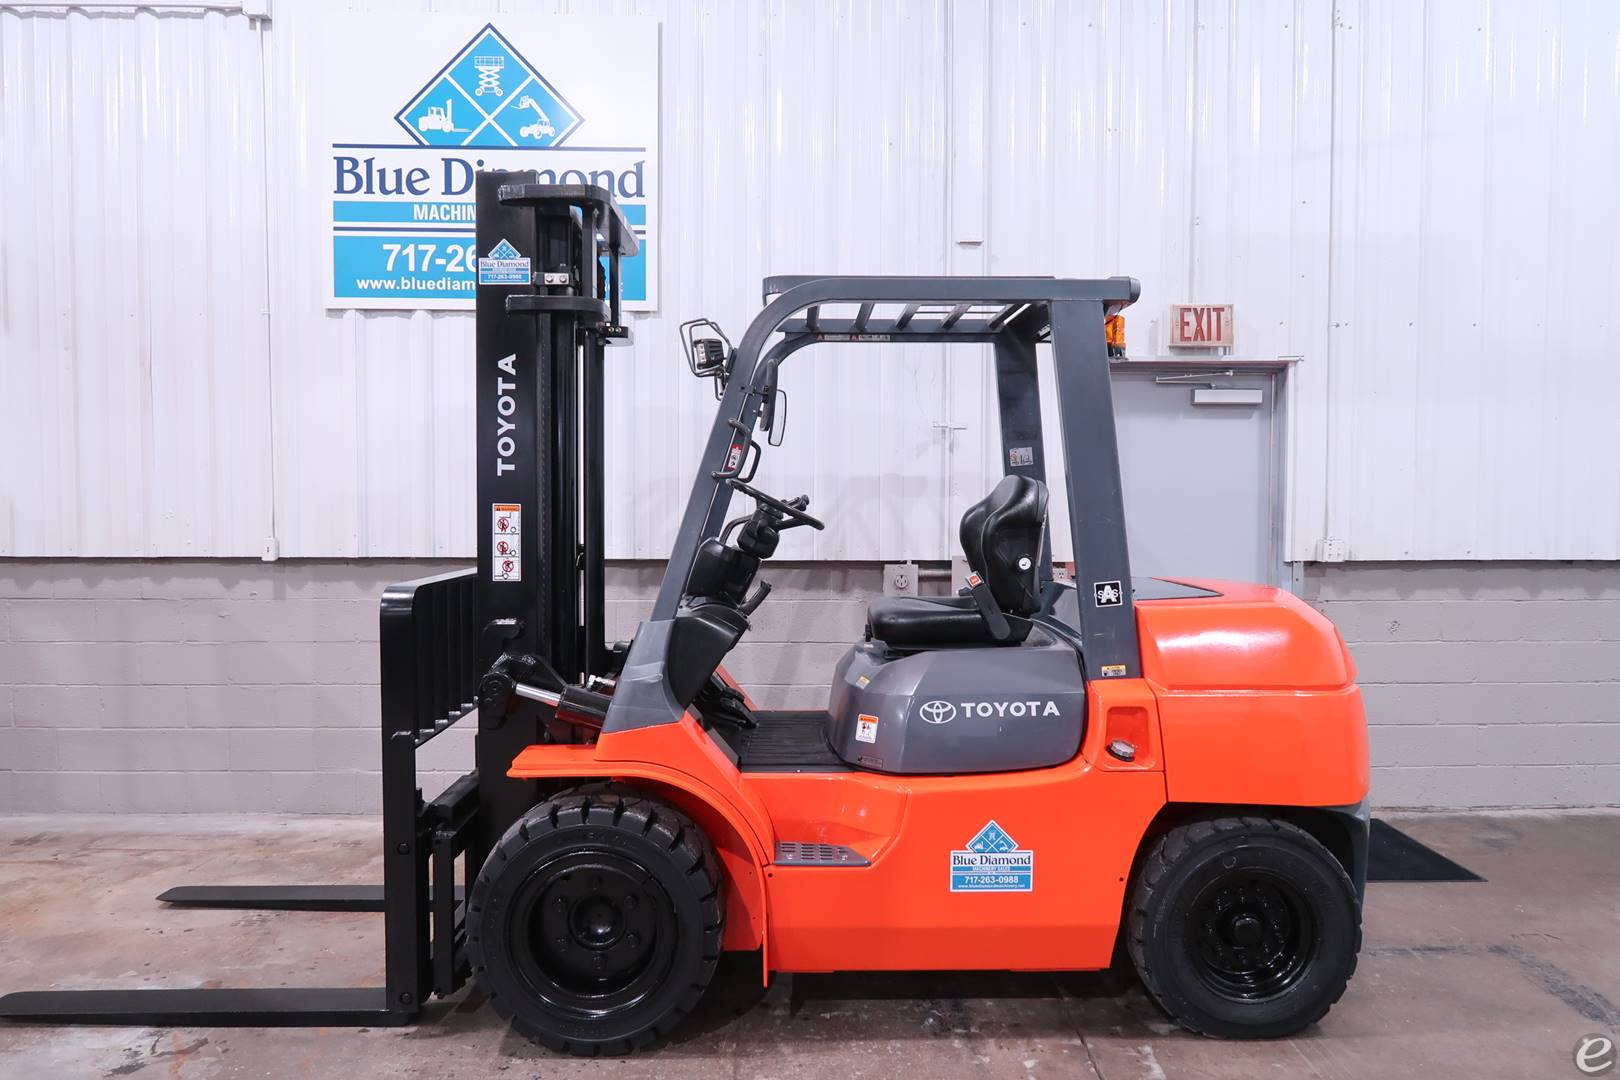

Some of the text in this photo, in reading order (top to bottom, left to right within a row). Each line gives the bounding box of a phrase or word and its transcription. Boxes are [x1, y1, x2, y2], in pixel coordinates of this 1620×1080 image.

[333, 156, 646, 198] Blue Dond
[413, 204, 476, 221] MACHIN
[383, 244, 476, 272] 717-26
[1179, 307, 1225, 342] EXIT
[497, 353, 517, 477] TOYOTA
[961, 701, 1060, 718] TOYOTA
[953, 855, 1031, 865] Blue Diamond
[964, 875, 1019, 884] 717-263-0988
